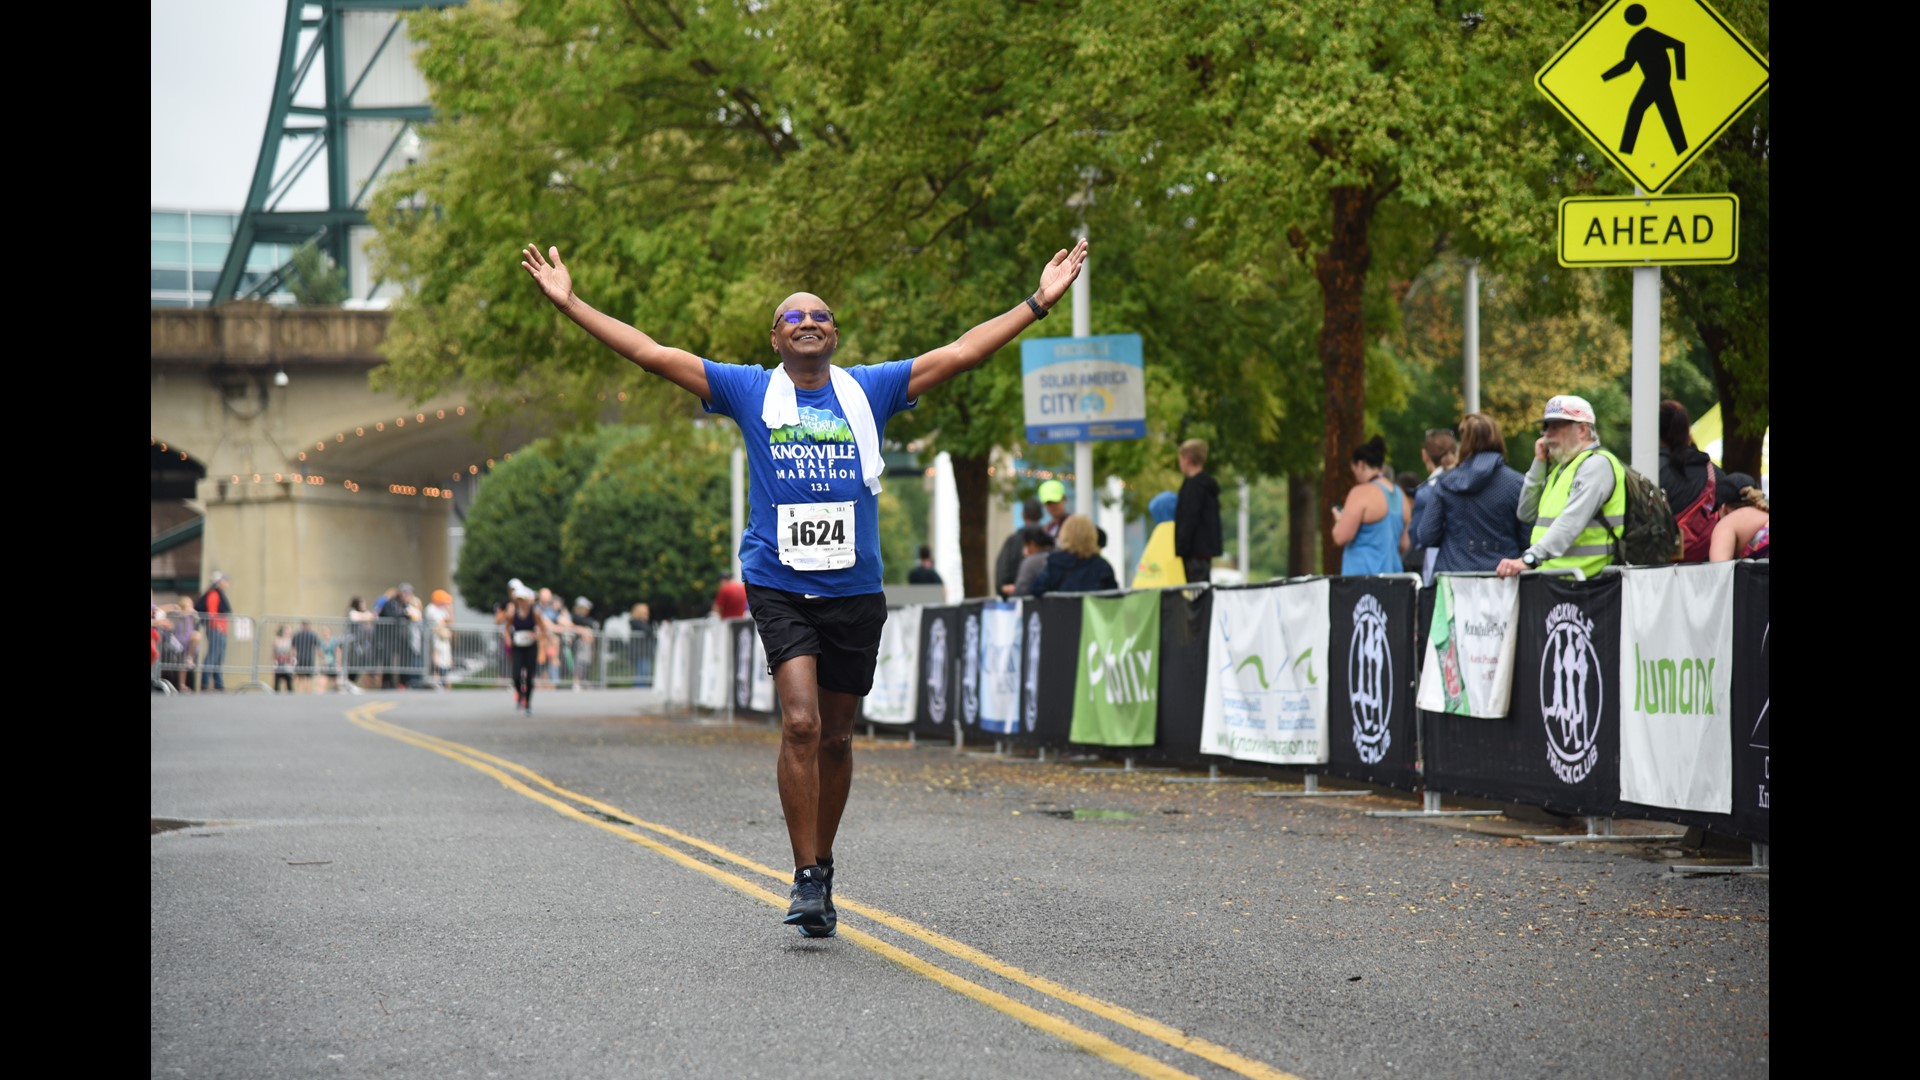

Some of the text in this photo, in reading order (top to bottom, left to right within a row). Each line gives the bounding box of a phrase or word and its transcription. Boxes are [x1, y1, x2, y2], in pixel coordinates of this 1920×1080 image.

[1583, 214, 1714, 246] AHEAD
[1040, 371, 1128, 387] SOLAR AMERICA
[1040, 394, 1077, 414] CITY
[770, 444, 856, 460] KNOXVILLE
[795, 459, 835, 469] HALF
[776, 469, 856, 479] MARATHON
[811, 483, 830, 491] 13.1
[787, 520, 845, 546] 1624
[1545, 602, 1594, 640] KNOXVILLE
[1546, 741, 1598, 784] TRACK CLUB
